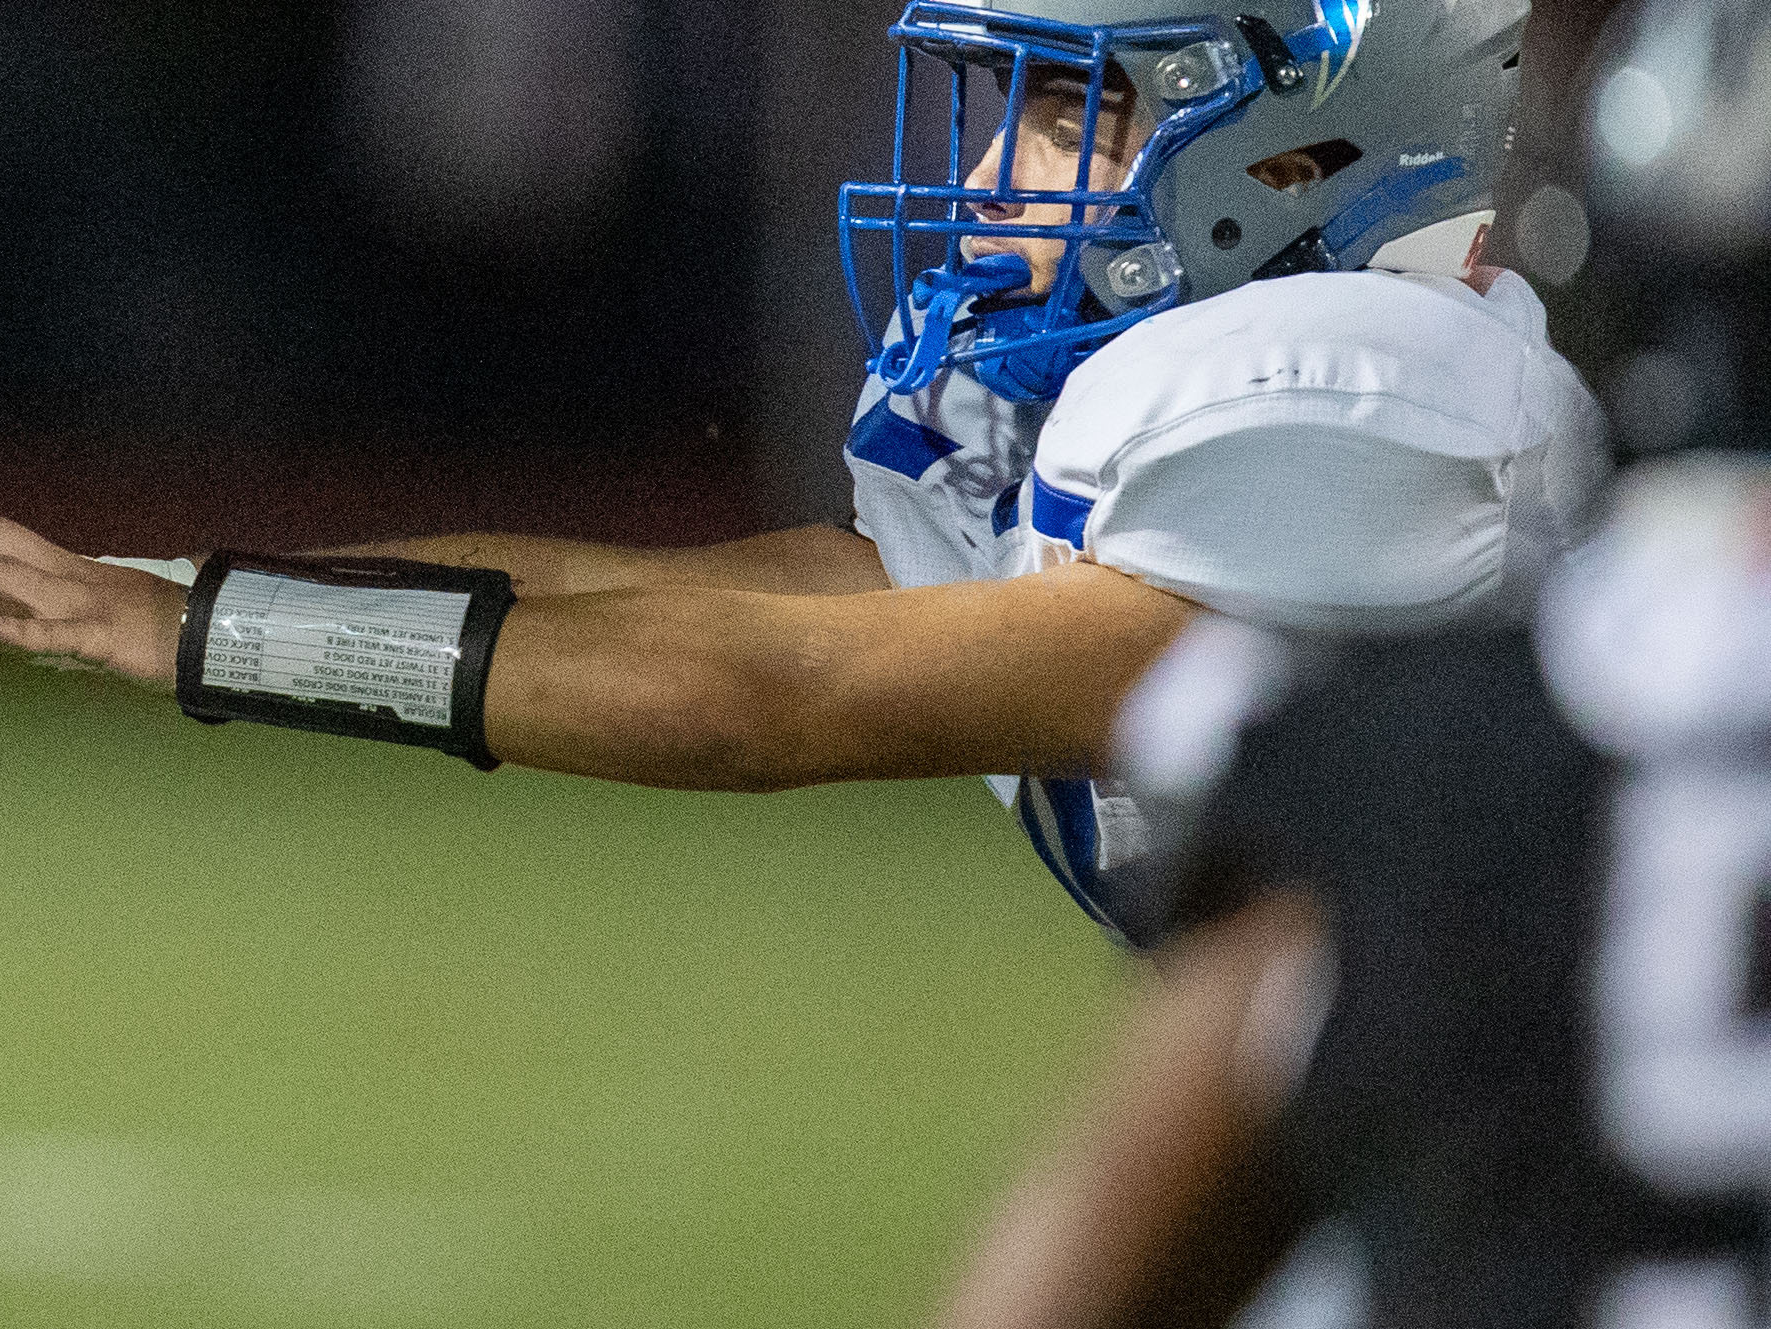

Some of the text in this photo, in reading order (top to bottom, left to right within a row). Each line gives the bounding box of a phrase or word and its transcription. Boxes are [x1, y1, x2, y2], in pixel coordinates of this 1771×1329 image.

[229, 640, 260, 652] BLACK
[228, 656, 259, 667] BLACK
[331, 651, 355, 663] DOG
[356, 654, 376, 666] RED
[227, 671, 258, 682] BLACK
[312, 666, 344, 677] CROSS
[290, 678, 323, 690] CROSS
[402, 706, 447, 720] REGULAR
